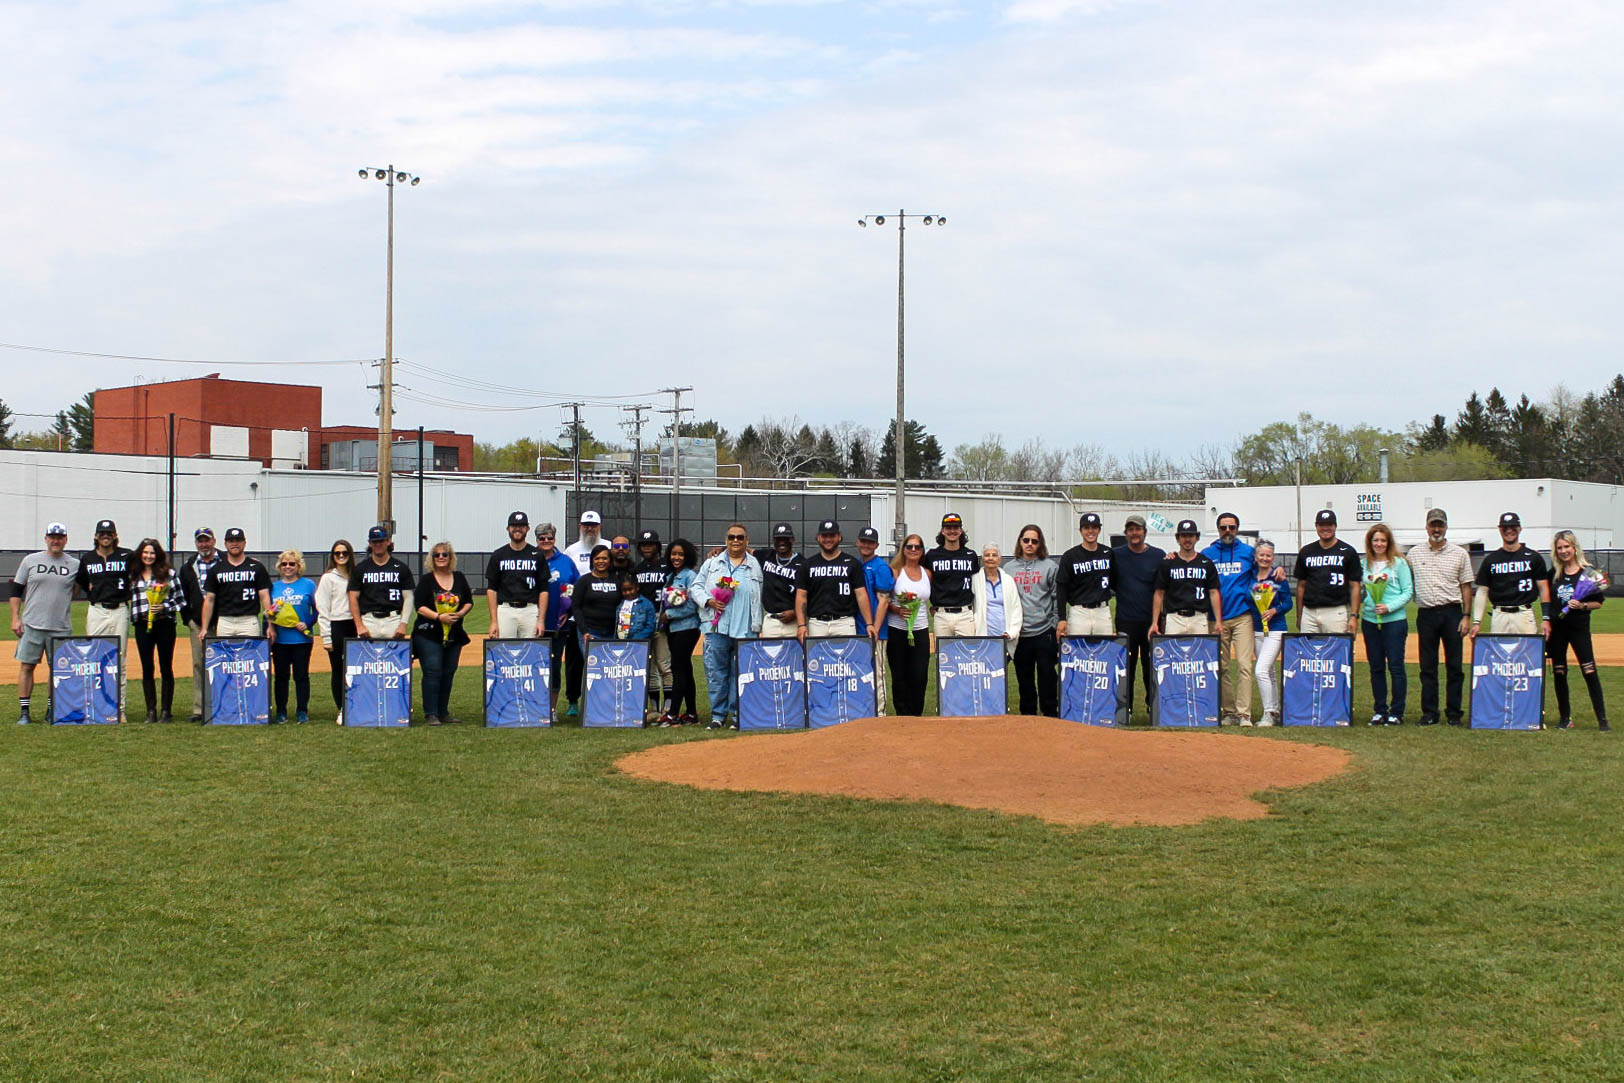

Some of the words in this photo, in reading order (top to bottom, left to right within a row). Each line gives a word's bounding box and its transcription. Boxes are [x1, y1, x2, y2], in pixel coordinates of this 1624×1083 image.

[1357, 494, 1381, 503] SPACE
[1357, 503, 1382, 511] AVAILABLE
[87, 561, 126, 574] PHOENIX
[500, 560, 537, 571] PHOENIX
[933, 559, 972, 571] PHOENIX
[1073, 559, 1110, 574] PHOENIX
[1305, 555, 1344, 567] PHOENIX
[1490, 560, 1532, 574] PHOENIX
[37, 563, 70, 577] DAD
[217, 570, 256, 583] PHOENIX
[763, 560, 796, 580] PHOENIX
[809, 565, 848, 578] PHOENIX
[118, 577, 124, 589] 2
[363, 572, 400, 583] PHOENIX
[1013, 575, 1043, 585] FIGHT
[1329, 572, 1345, 586] 39
[838, 582, 851, 596] 18
[1518, 578, 1533, 592] 23
[242, 588, 256, 601] 24
[71, 662, 102, 676] PHOENIX
[222, 659, 255, 674] PHOENIX
[364, 661, 396, 675] PHOENIX
[500, 664, 533, 679] PHOENIX
[603, 664, 634, 679] PHOENIX
[758, 665, 792, 681] PHOENIX
[1074, 658, 1108, 675] PHOENIX
[1171, 660, 1204, 675] PHOENIX
[1300, 658, 1335, 674] PHOENIX
[1491, 662, 1526, 677] PHOENIX
[95, 676, 102, 690] 2
[244, 674, 259, 688] 24
[385, 675, 399, 689] 22
[523, 679, 535, 693] 41
[625, 678, 632, 691] 3
[784, 680, 792, 694] 7
[847, 678, 858, 692] 18
[983, 676, 991, 690] 11
[1094, 676, 1108, 690] 20
[1195, 675, 1207, 689] 15
[1321, 674, 1336, 689] 39
[1514, 677, 1529, 692] 23
